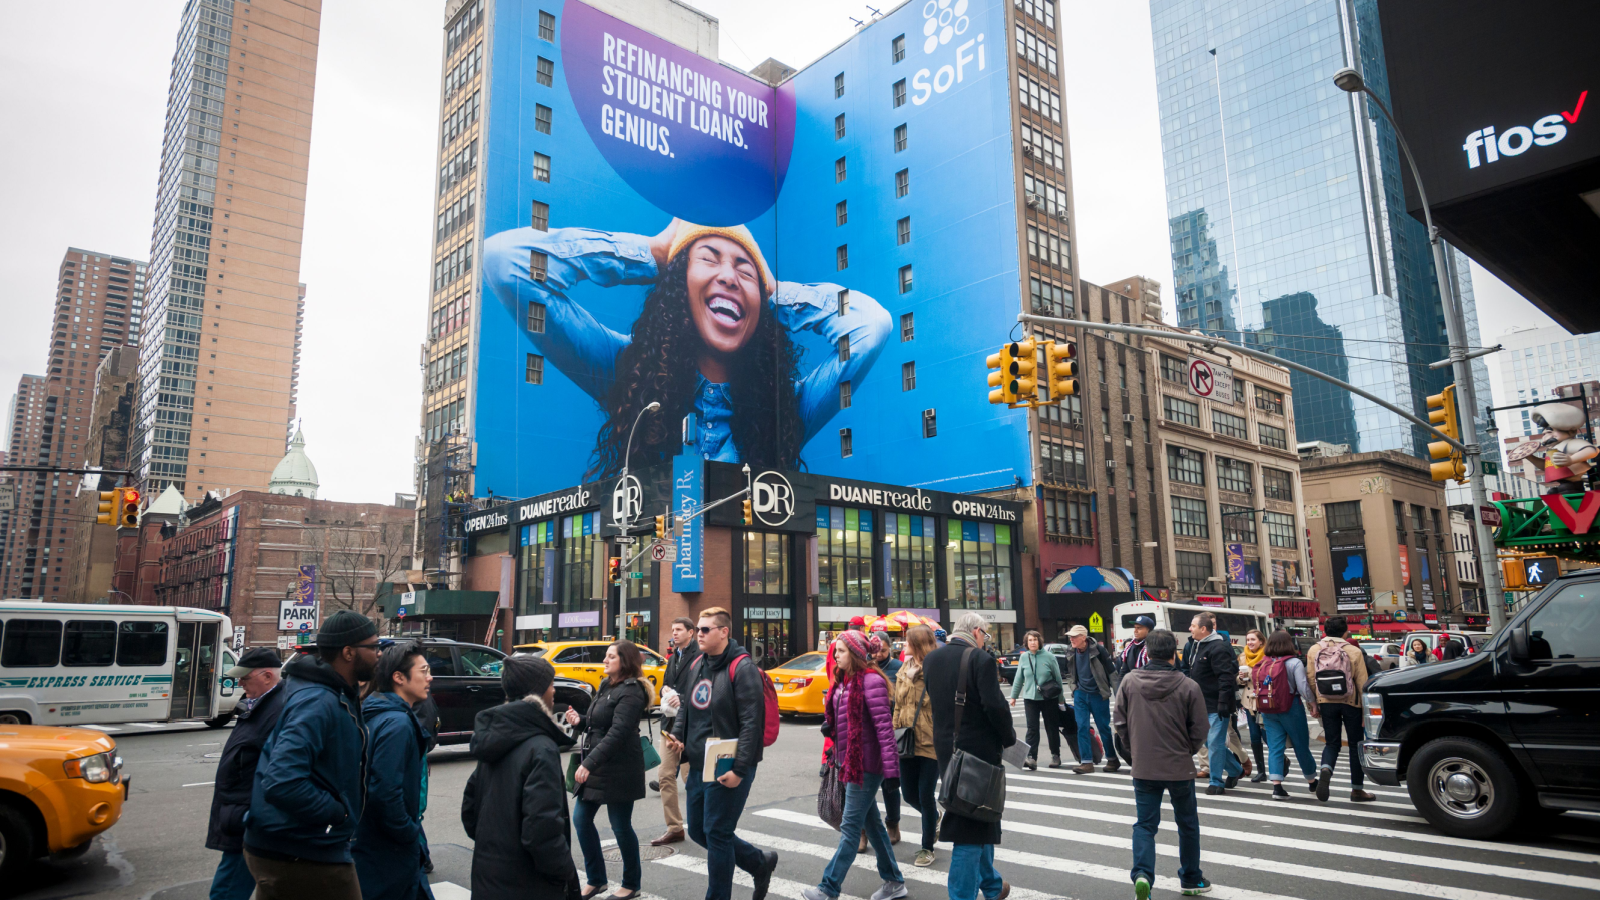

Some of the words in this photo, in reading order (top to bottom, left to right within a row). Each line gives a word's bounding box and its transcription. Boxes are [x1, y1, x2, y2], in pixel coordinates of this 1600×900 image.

[912, 33, 985, 105] SoFi
[604, 32, 721, 109] REFINANCING
[727, 86, 768, 128] YOUR
[602, 65, 685, 124] STUDENT
[690, 100, 748, 150] LOANS.
[602, 103, 675, 158] GENIUS.
[1462, 114, 1567, 169] fios
[1215, 380, 1230, 389] EXCEPT
[1216, 390, 1230, 400] BUSES
[1484, 462, 1489, 473] 8
[952, 499, 986, 518] OPEN
[283, 608, 315, 620] PARK
[28, 676, 87, 688] EXPRESS
[89, 675, 142, 687] SERVICE
